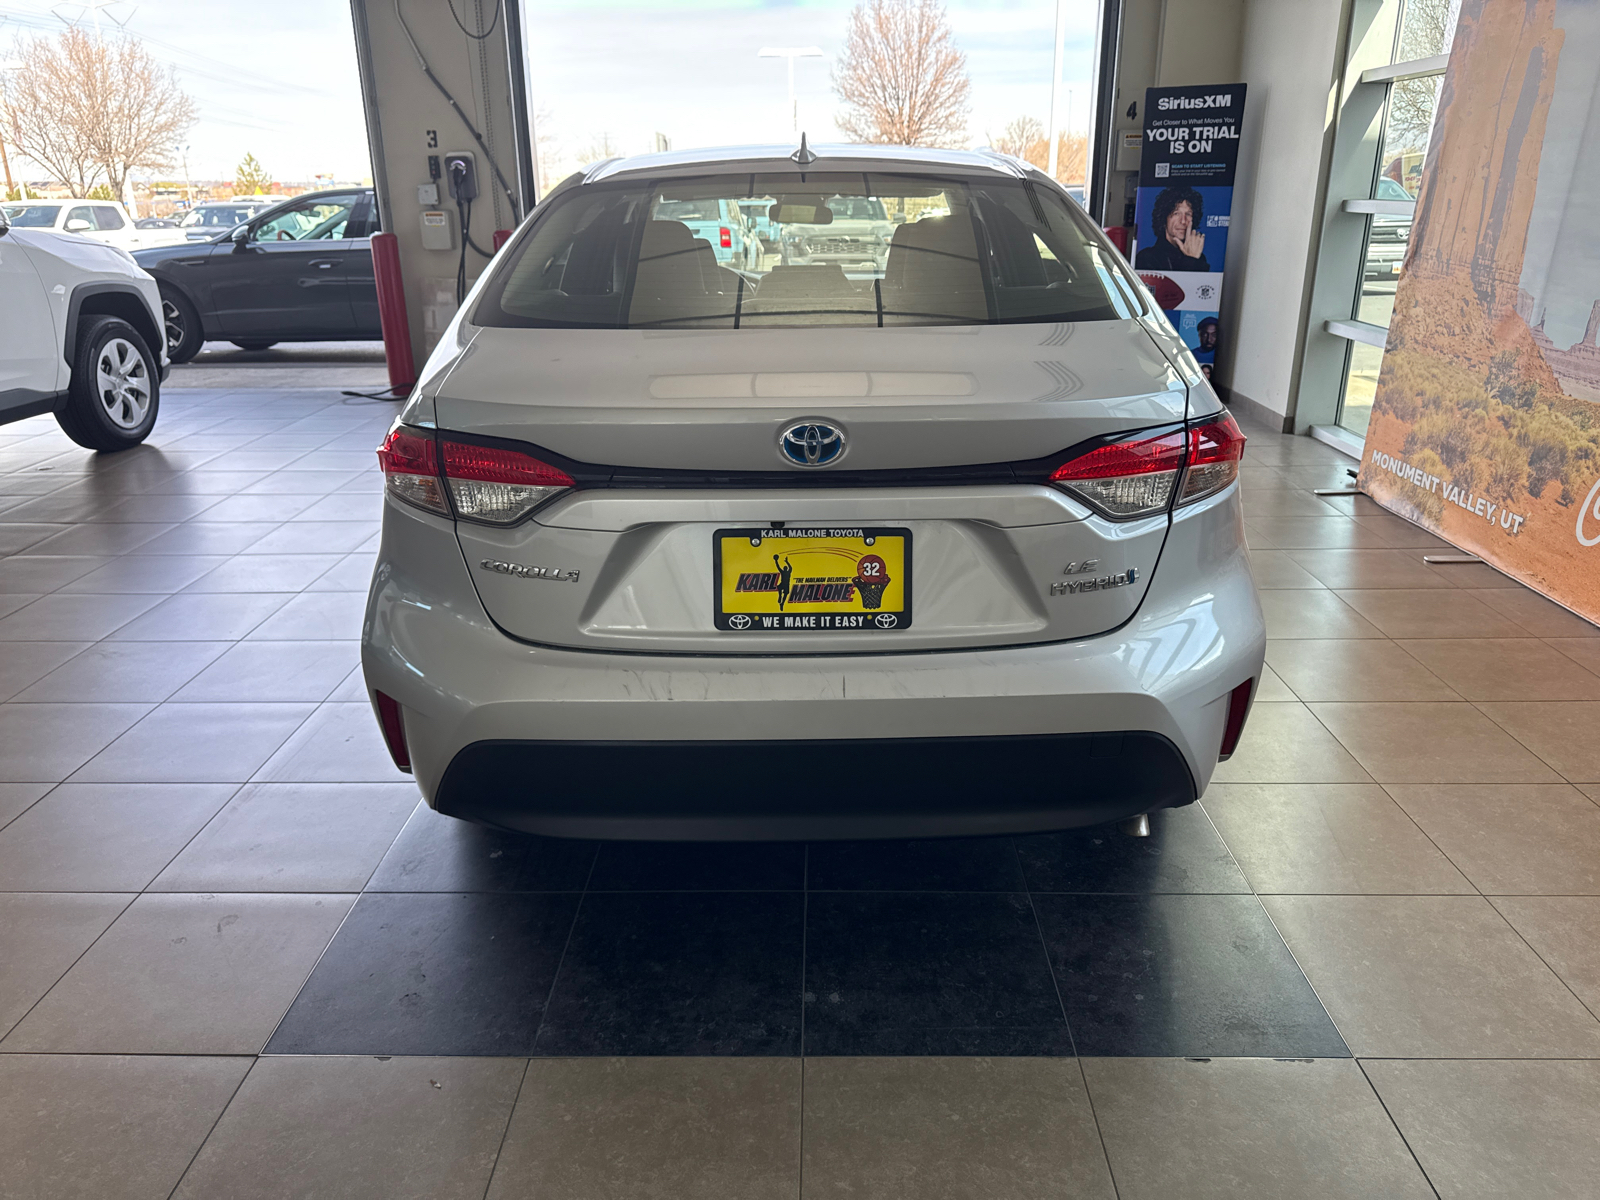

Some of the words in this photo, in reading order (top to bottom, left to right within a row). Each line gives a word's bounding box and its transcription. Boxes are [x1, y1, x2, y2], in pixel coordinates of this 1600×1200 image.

[1126, 101, 1137, 120] 4
[1158, 94, 1232, 111] SiriusXM
[426, 130, 438, 148] 3
[1146, 127, 1189, 141] YOUR
[1192, 125, 1240, 139] TRIAL
[1169, 141, 1185, 154] IS
[1188, 140, 1212, 153] ON
[1371, 449, 1440, 494] MONUMENT
[1442, 481, 1497, 526] VALLEY,
[1500, 509, 1524, 534] UT
[760, 529, 786, 538] KARL
[788, 529, 827, 538] MALONE
[828, 529, 864, 538] TOYOTA
[480, 558, 580, 583] COROLLA
[863, 562, 880, 576] 32
[1063, 558, 1100, 575] LE
[735, 572, 780, 592] KARL
[1050, 572, 1127, 597] HYBRID
[788, 583, 855, 603] MALONE
[762, 616, 780, 628] WE
[784, 616, 816, 628] MAKE
[820, 615, 831, 627] IT
[835, 615, 864, 627] EASY
